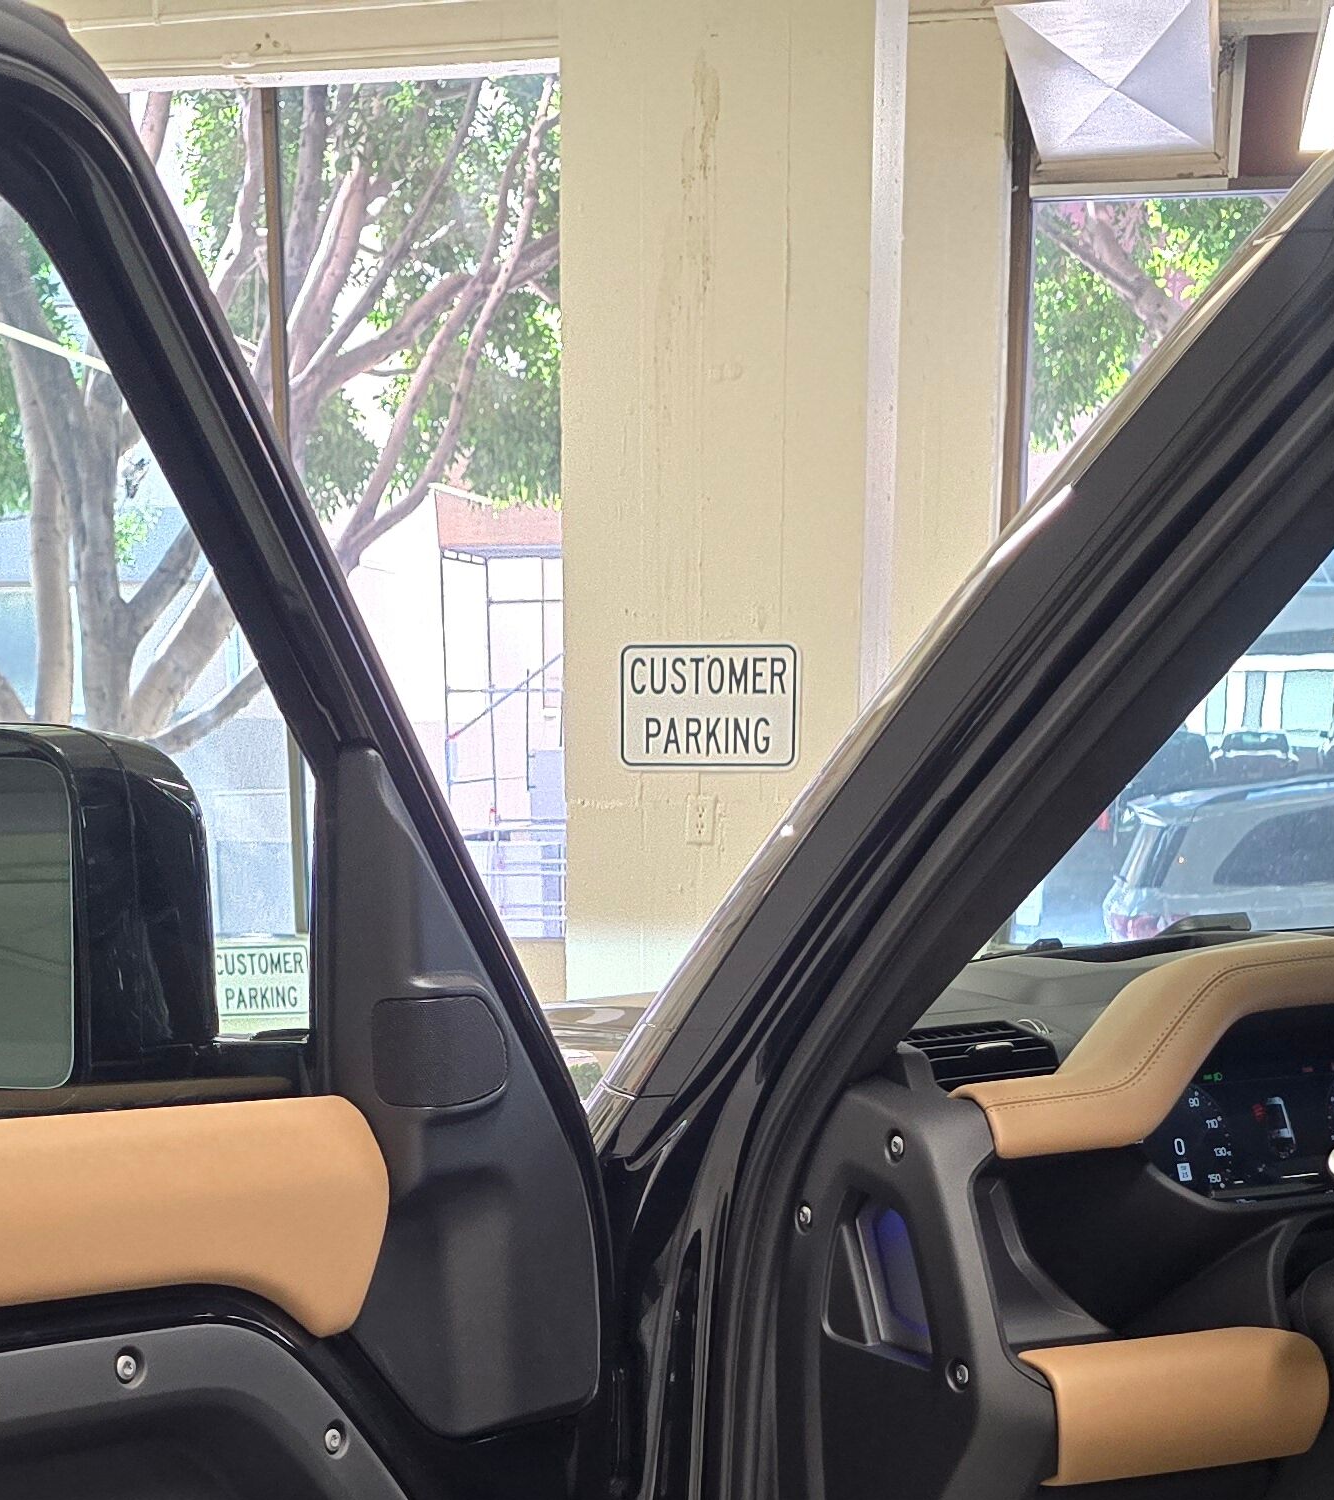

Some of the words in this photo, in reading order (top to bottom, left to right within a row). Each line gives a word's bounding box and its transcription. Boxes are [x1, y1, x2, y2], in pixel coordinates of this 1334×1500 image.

[631, 657, 787, 694] CUSTOMER
[645, 717, 770, 755] PARKING
[225, 986, 298, 1009] PARKING
[1189, 1097, 1200, 1107] 90
[1206, 1119, 1218, 1129] 110
[1174, 1138, 1185, 1155] 0
[1214, 1147, 1227, 1157] 130
[1208, 1173, 1221, 1183] 150
